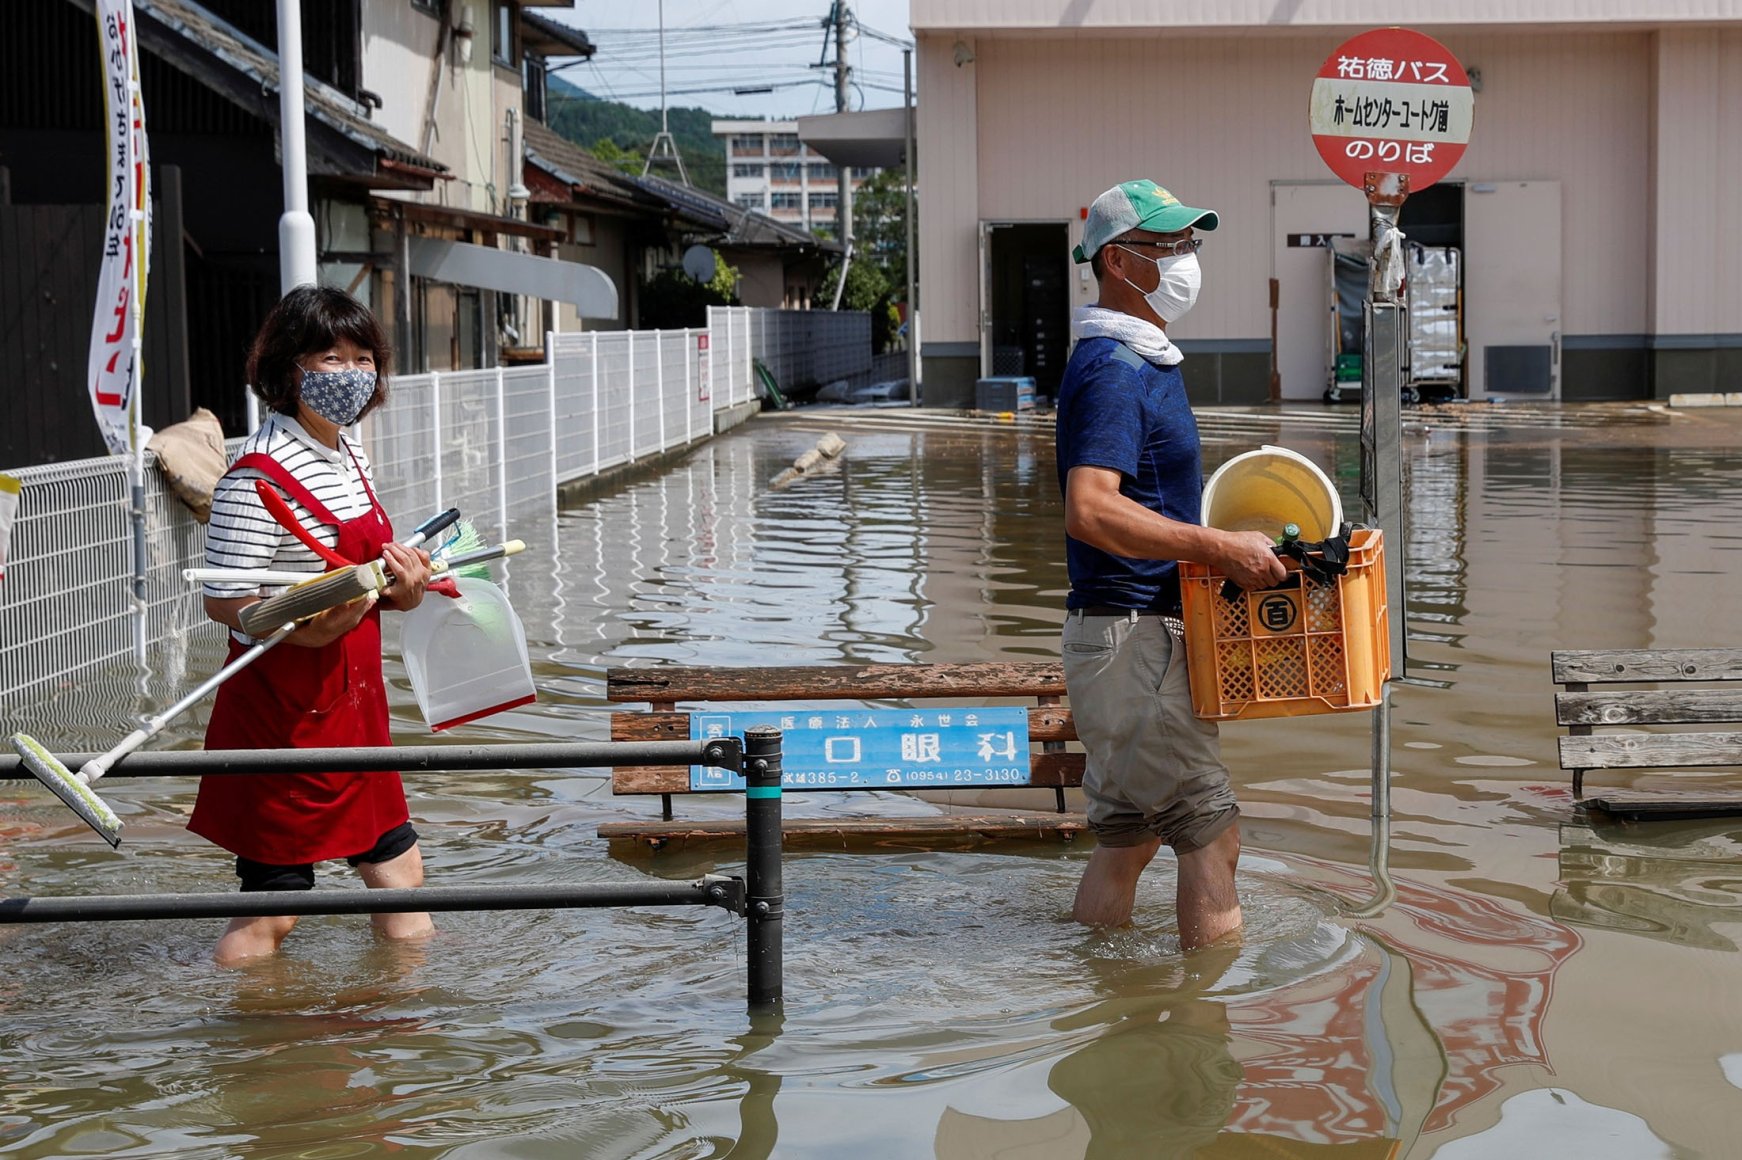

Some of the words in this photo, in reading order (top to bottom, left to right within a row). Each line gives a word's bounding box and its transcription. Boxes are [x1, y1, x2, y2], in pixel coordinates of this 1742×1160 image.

[1337, 55, 1450, 83] 祐徳バス
[1333, 94, 1449, 133] ホームセンターユートク前
[1345, 140, 1435, 164] のりば
[1264, 600, 1289, 625] 百
[781, 715, 877, 729] 医療法人
[910, 714, 978, 727] 永世会
[954, 768, 1019, 781] 23-3130
